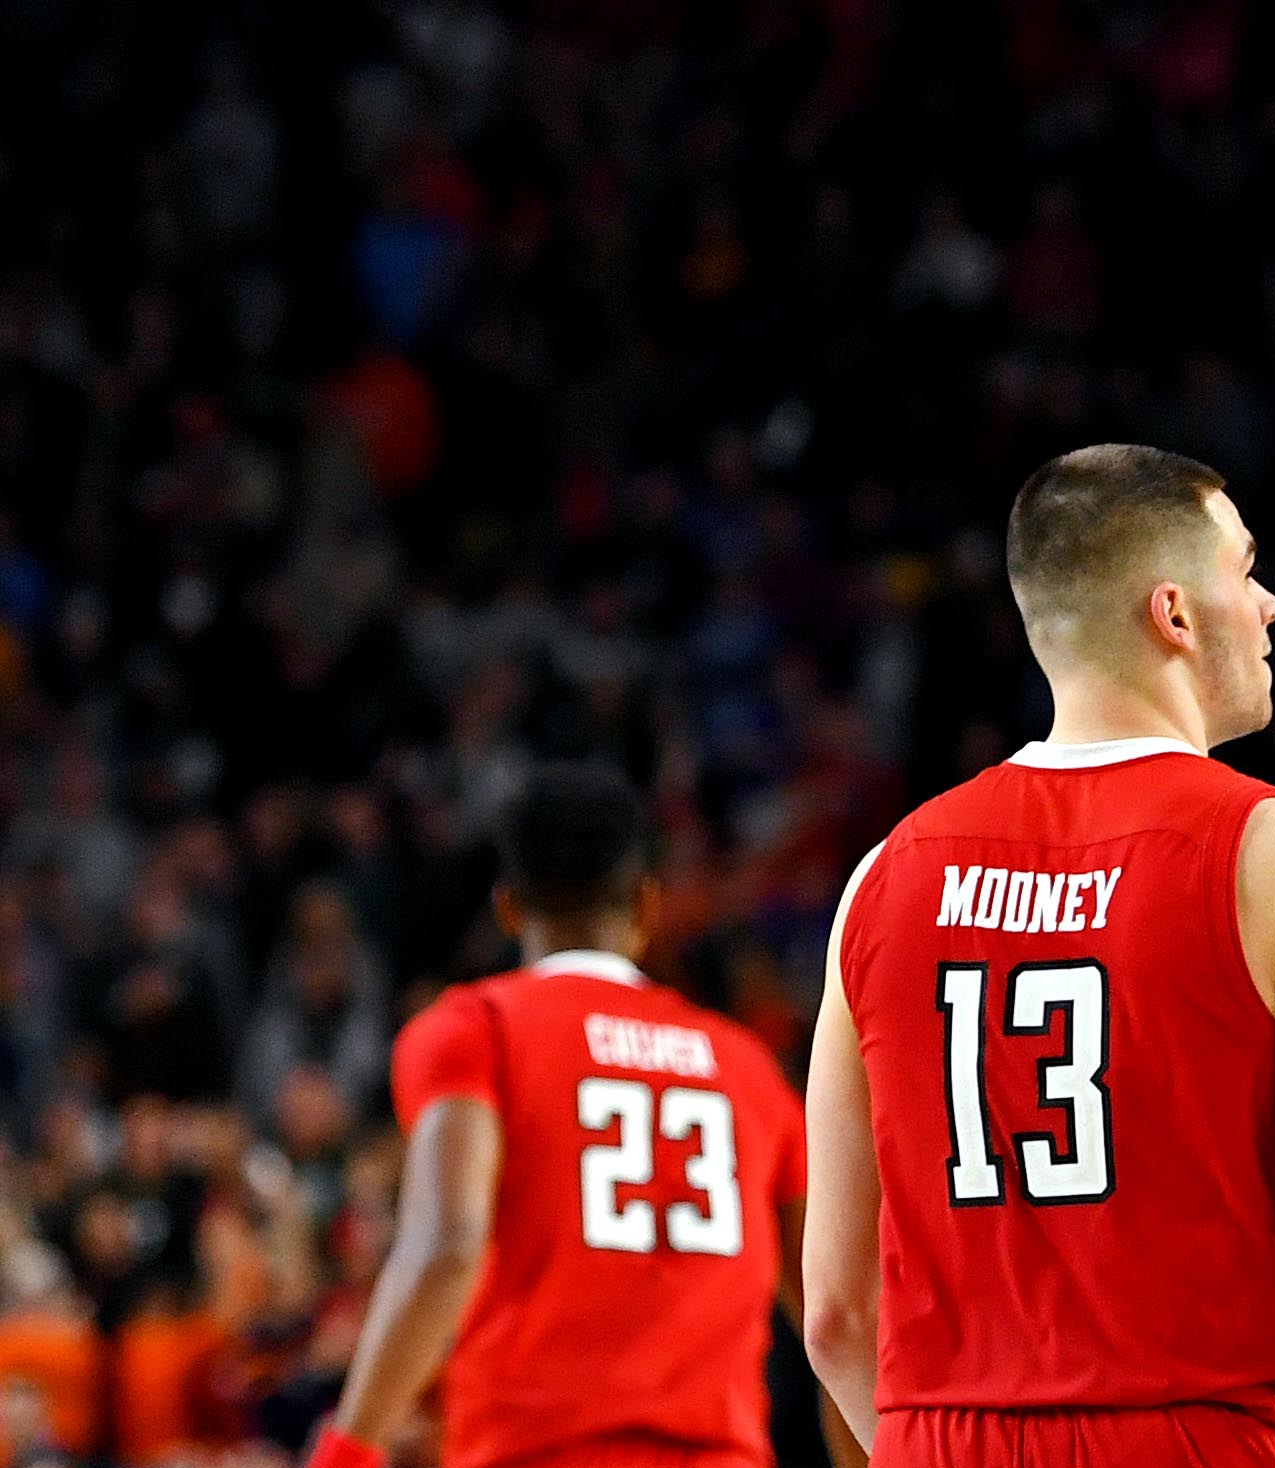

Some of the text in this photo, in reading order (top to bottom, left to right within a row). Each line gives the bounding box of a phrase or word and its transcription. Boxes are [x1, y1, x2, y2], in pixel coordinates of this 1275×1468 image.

[936, 864, 1122, 933] MOONEY
[576, 1075, 745, 1258] 23
[936, 957, 1117, 1208] 13
